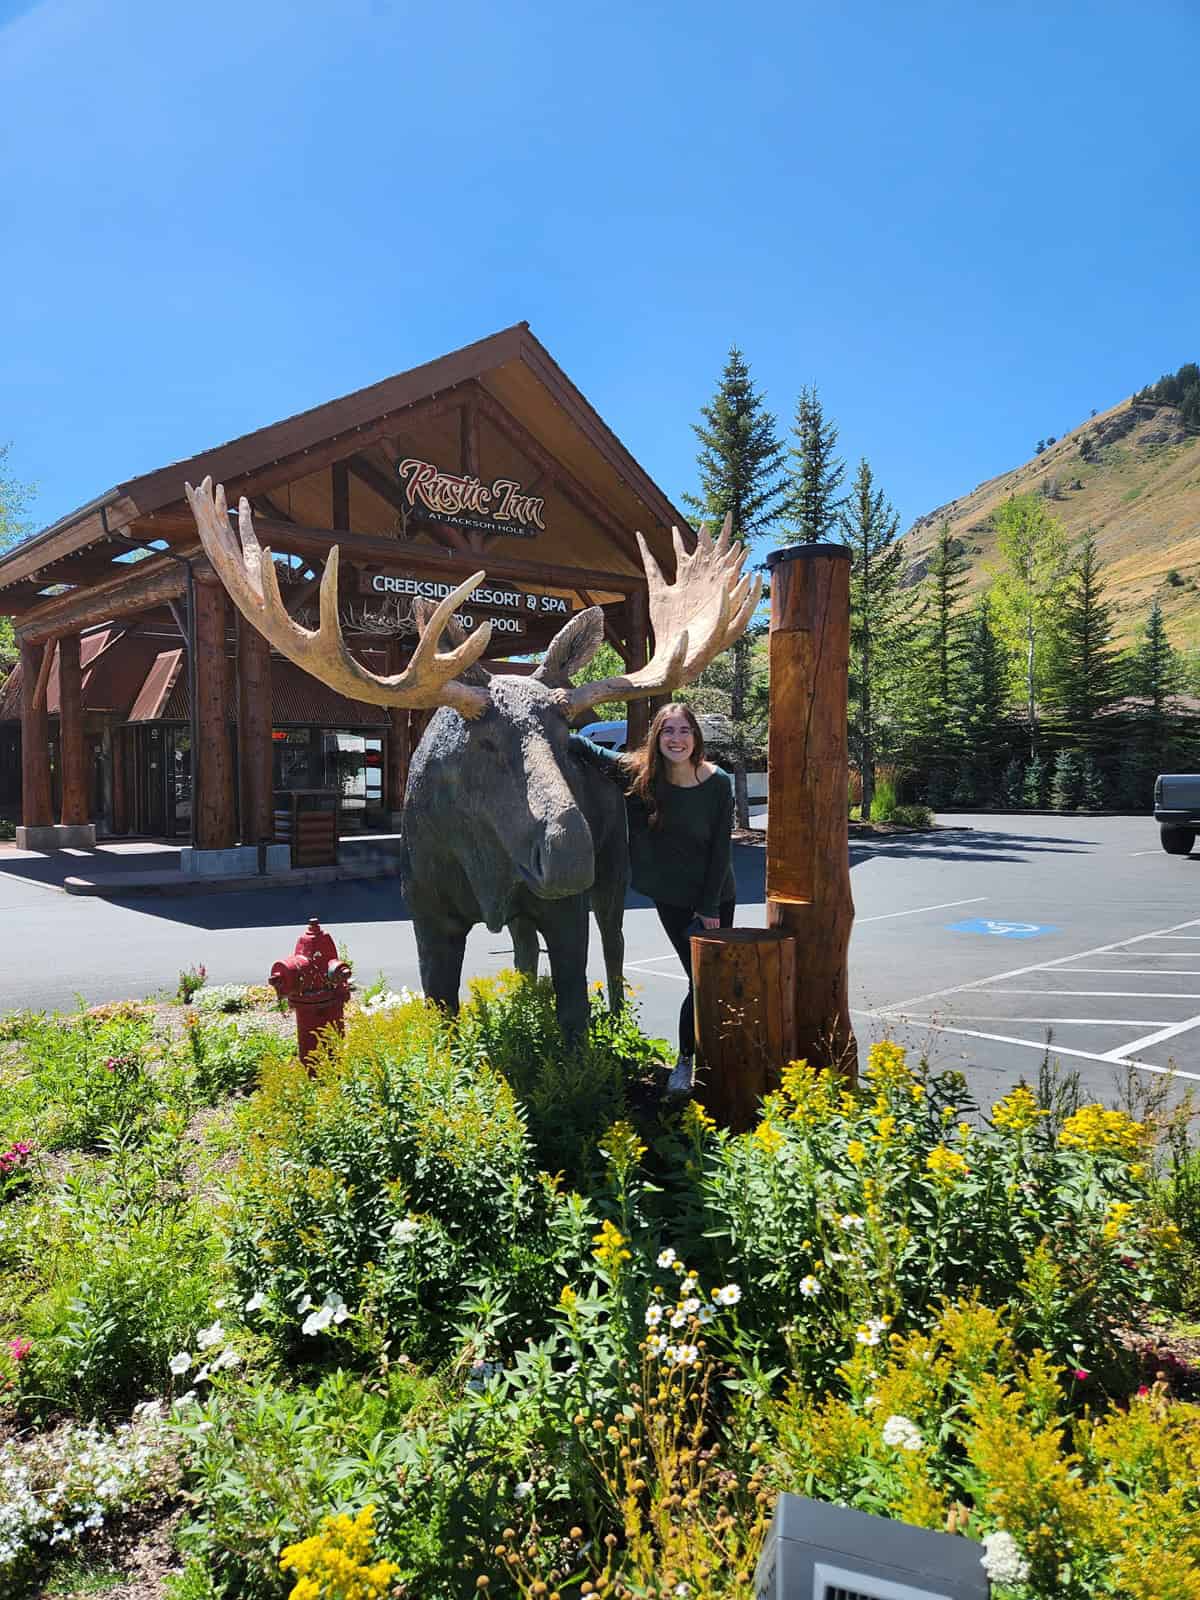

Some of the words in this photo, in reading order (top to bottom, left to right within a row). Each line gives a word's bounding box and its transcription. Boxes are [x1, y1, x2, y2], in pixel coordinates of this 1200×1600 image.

[399, 458, 492, 515] Rustic
[493, 479, 546, 530] Inn
[428, 512, 443, 520] AT
[447, 515, 495, 530] JACKSON
[498, 524, 526, 535] HOLE
[466, 588, 521, 607] RESORT
[541, 597, 567, 613] SPA
[489, 617, 523, 633] POOL
